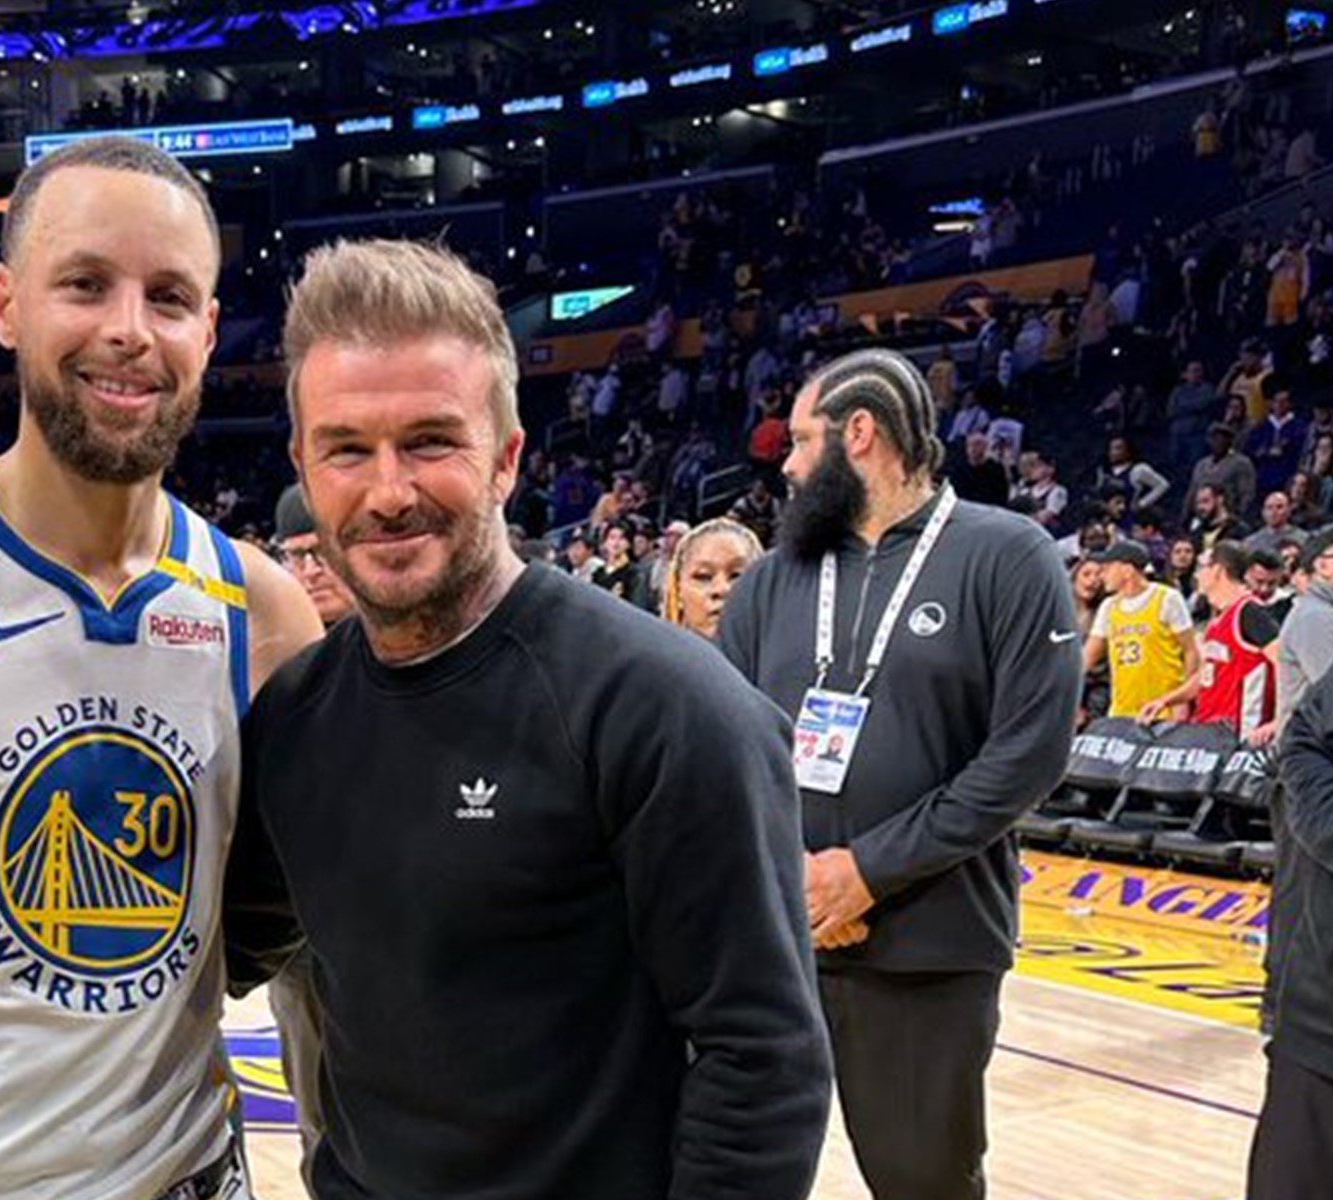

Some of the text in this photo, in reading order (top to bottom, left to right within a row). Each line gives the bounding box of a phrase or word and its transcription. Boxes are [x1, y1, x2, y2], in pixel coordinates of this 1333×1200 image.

[149, 612, 226, 646] Rakuten
[132, 704, 206, 785] STATE
[113, 790, 180, 858] 30
